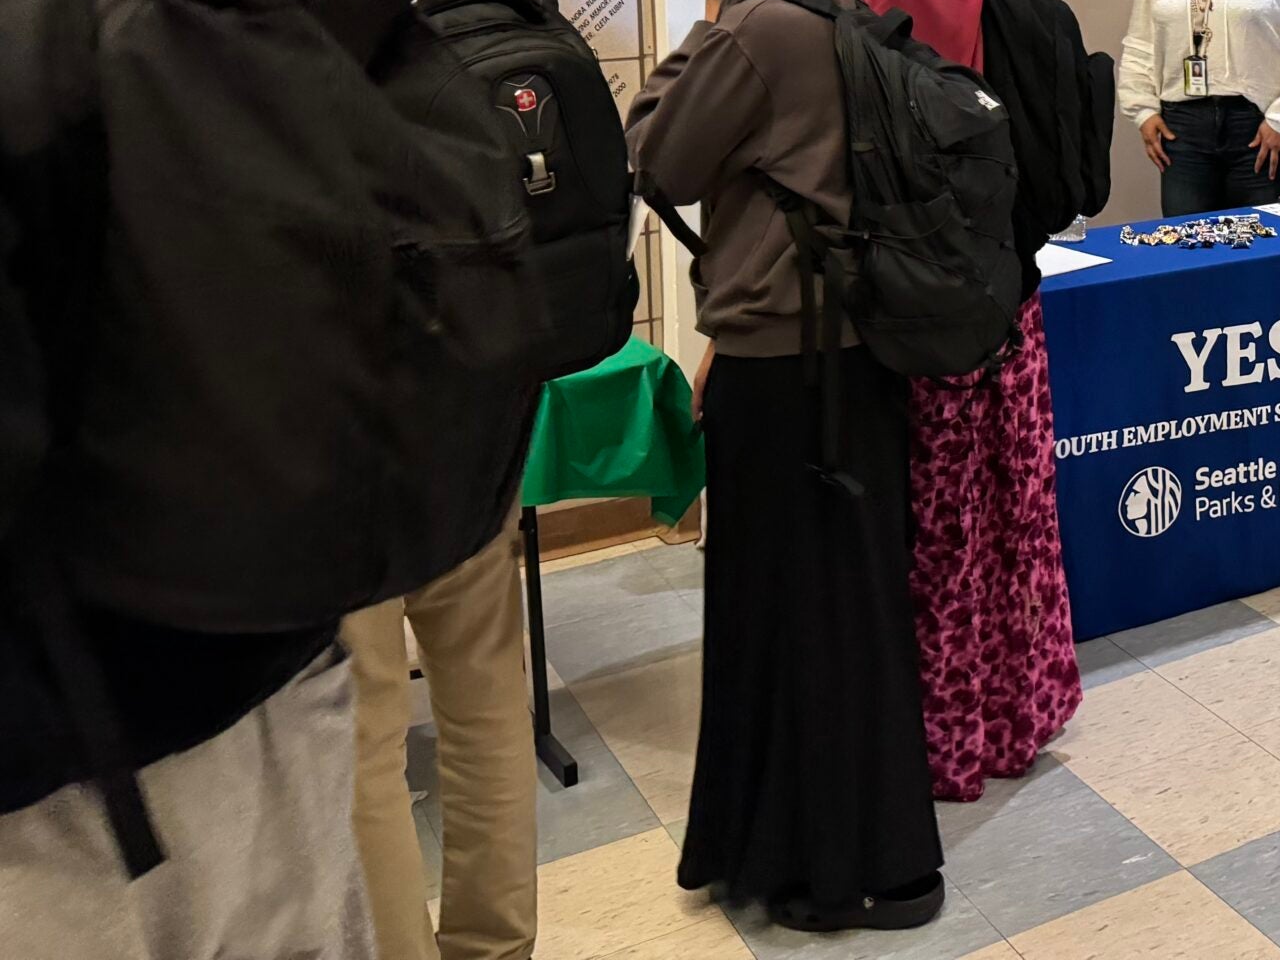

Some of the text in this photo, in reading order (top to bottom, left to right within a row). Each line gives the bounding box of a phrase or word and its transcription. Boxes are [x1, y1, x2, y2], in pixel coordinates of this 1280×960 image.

[1122, 405, 1271, 448] EMPLOYMENT
[1195, 457, 1277, 491] Seattle
[1195, 492, 1255, 521] Parks
[1260, 488, 1276, 509] &
